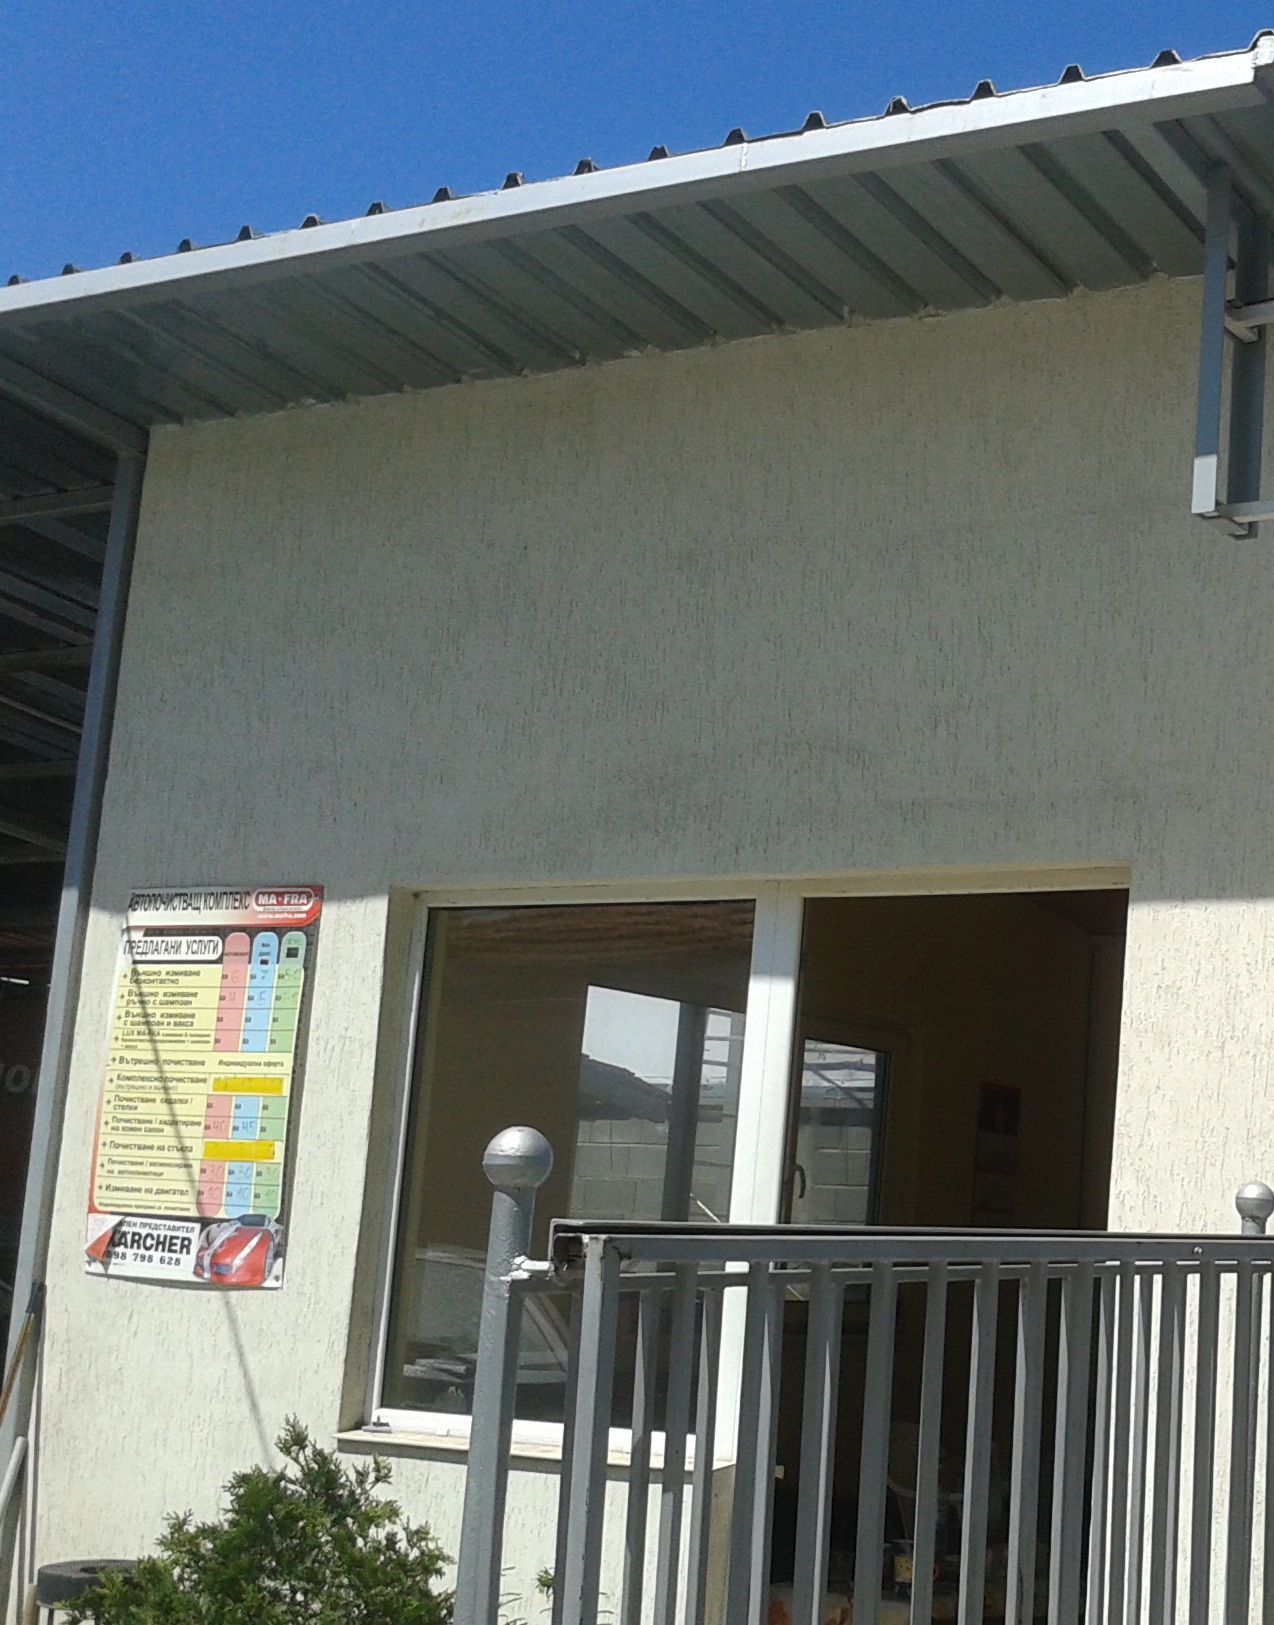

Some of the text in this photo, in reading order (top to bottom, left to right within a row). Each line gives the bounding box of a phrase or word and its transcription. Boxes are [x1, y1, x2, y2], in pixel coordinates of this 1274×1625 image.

[128, 891, 250, 914] АВТОПОЧИСТВАЩ КОМПЛЕКС
[123, 939, 220, 957] ПРЕДЛАГАНИ УСЛУГИ
[139, 1221, 195, 1234] ПРЕДСТАВИТЕЛ
[133, 1252, 153, 1263] 798
[159, 1255, 181, 1267] 628
